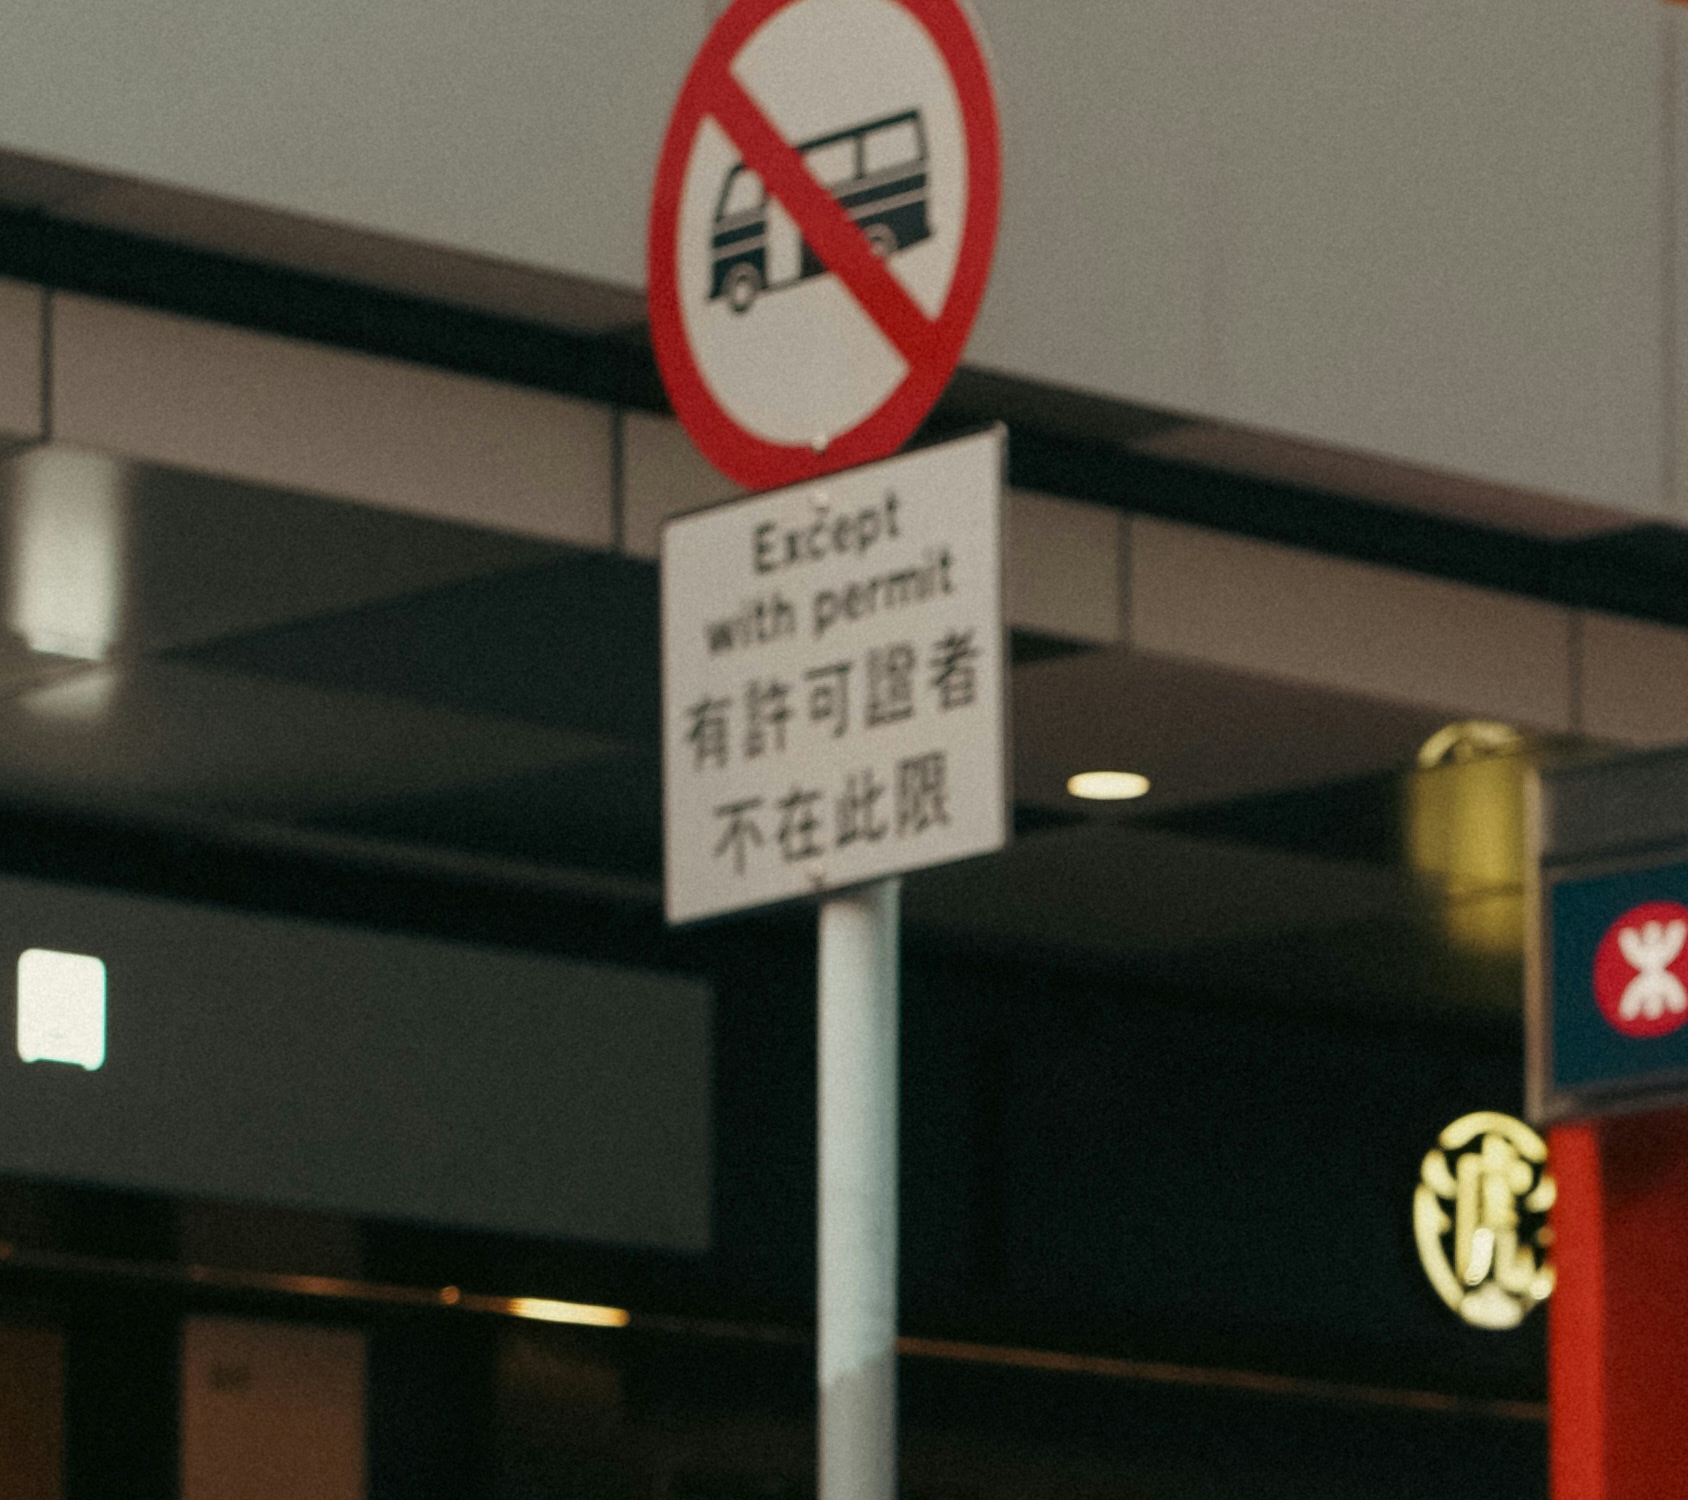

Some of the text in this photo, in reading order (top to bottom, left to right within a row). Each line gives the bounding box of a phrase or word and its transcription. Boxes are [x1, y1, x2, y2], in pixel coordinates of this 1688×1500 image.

[753, 488, 900, 574] Except
[706, 549, 954, 655] with permit
[685, 626, 980, 772] 有許可證者
[712, 750, 952, 877] 不在此限
